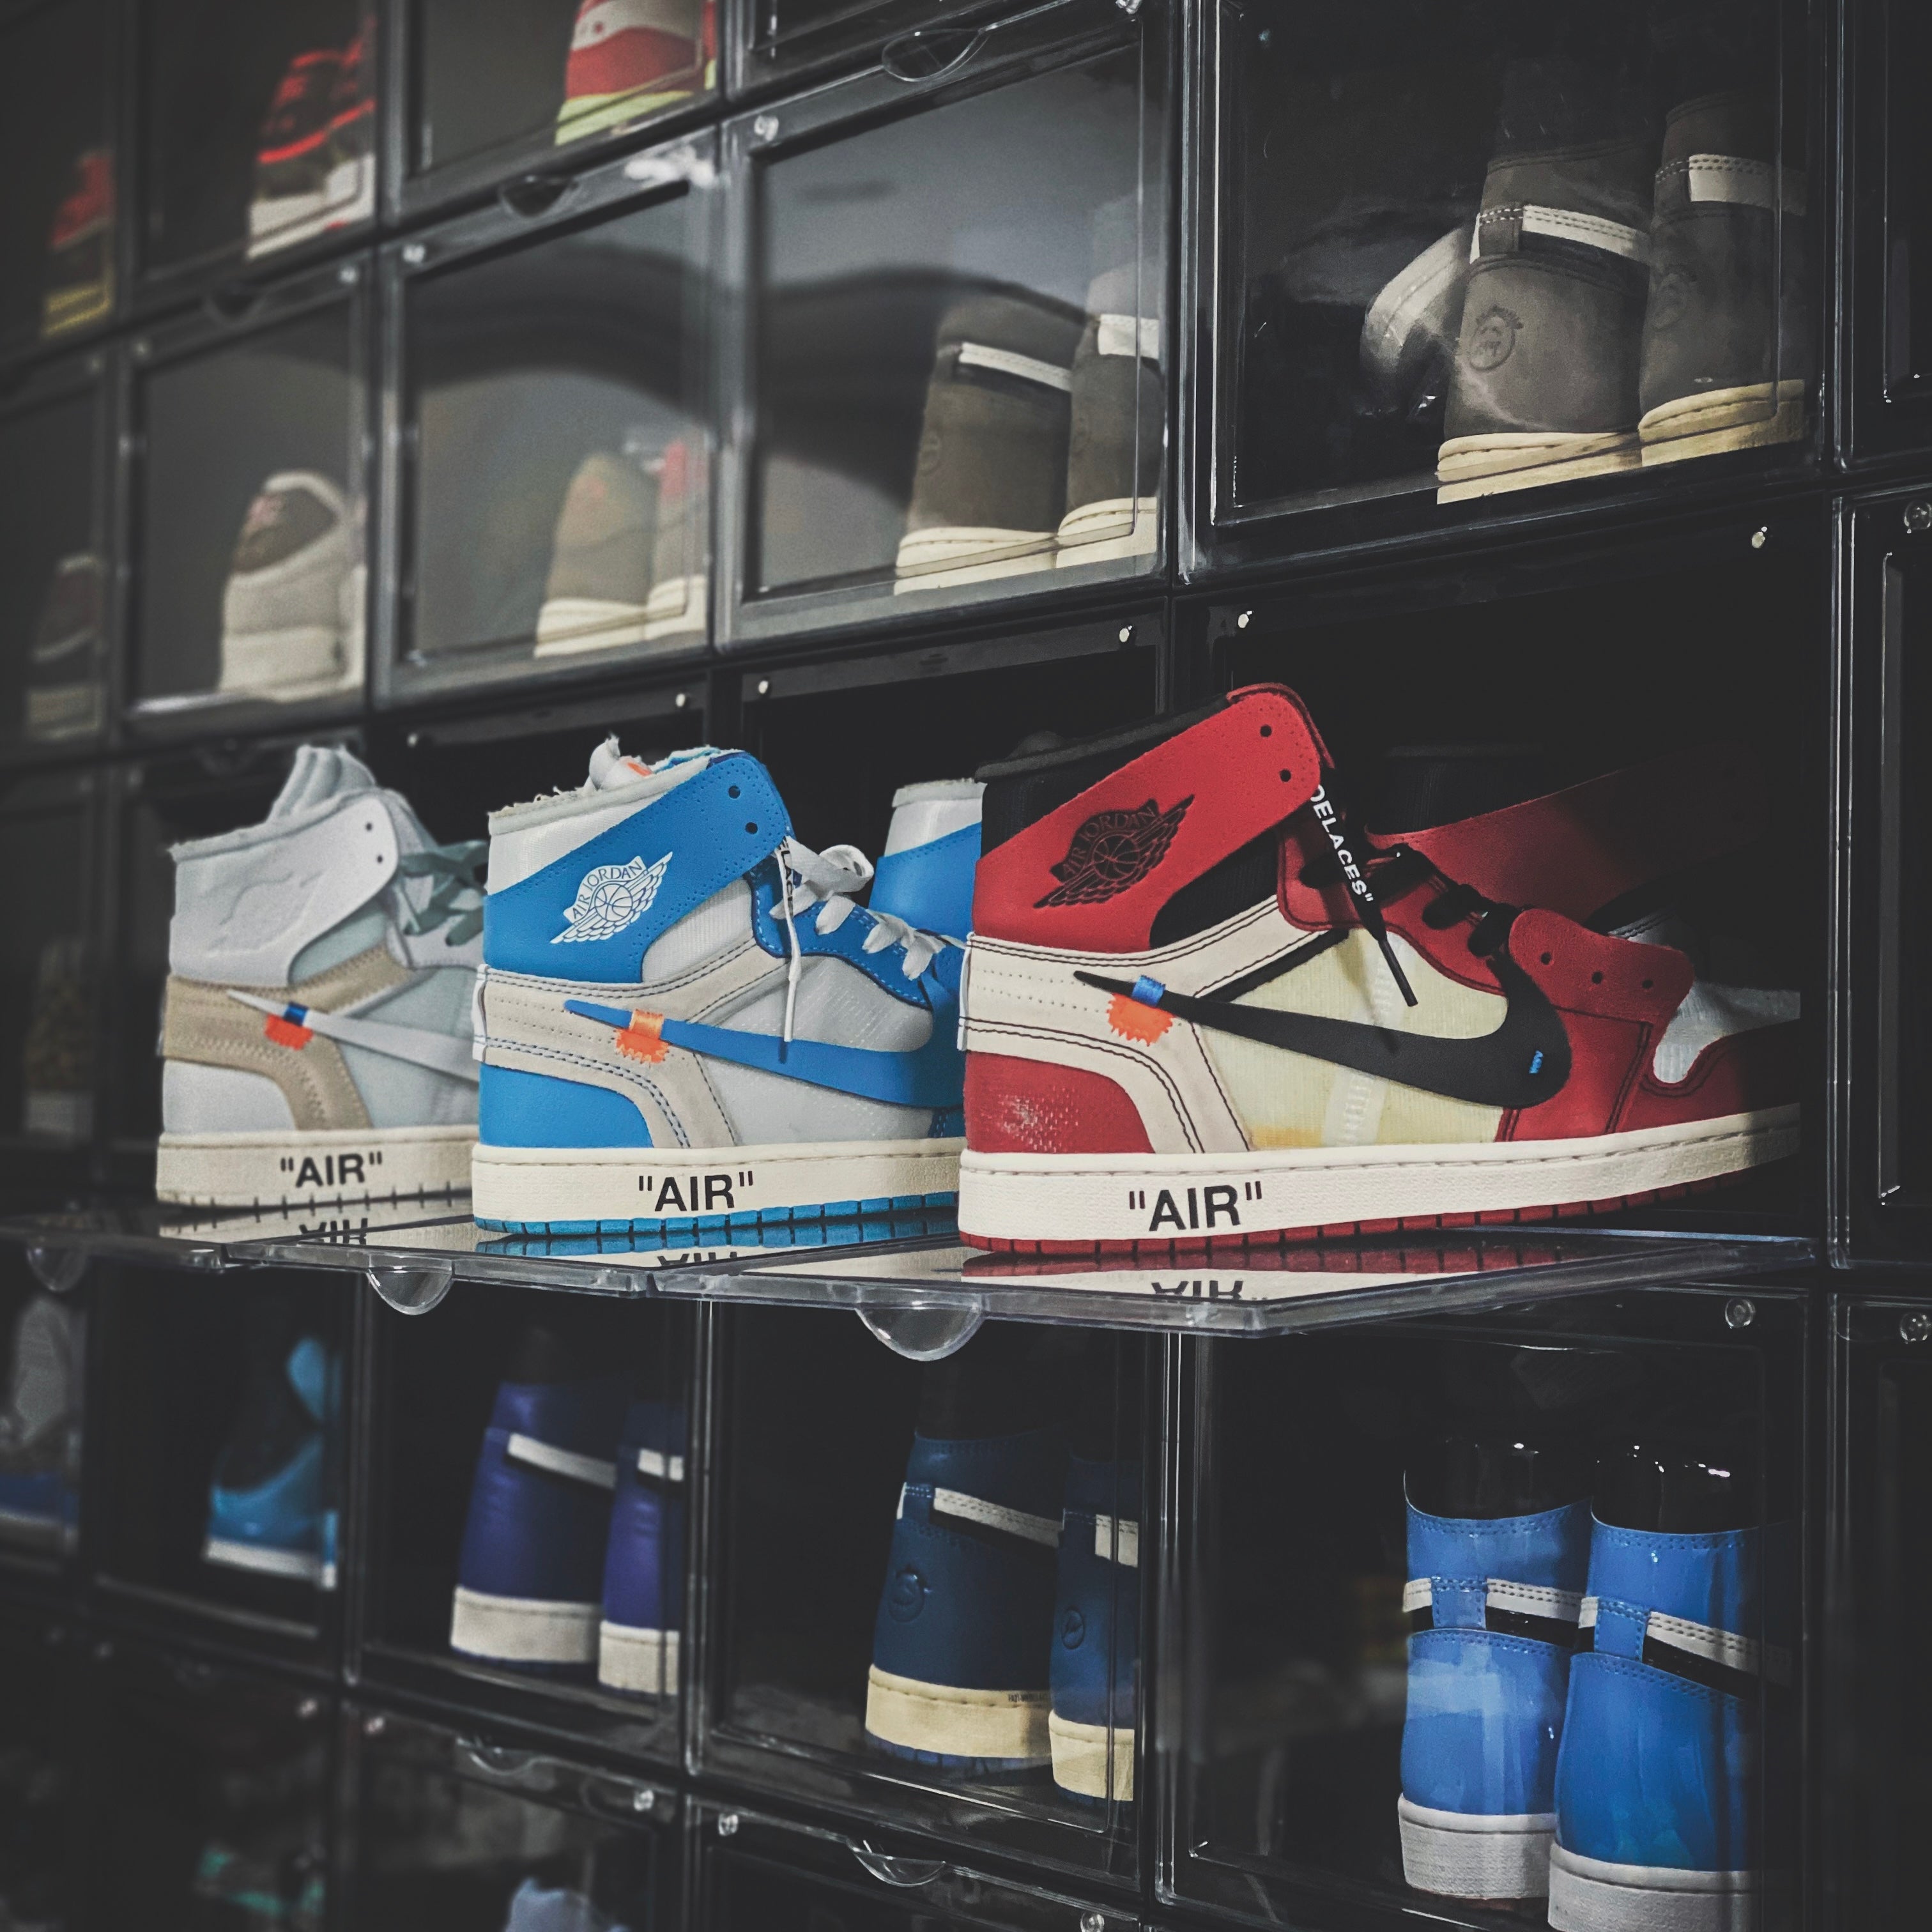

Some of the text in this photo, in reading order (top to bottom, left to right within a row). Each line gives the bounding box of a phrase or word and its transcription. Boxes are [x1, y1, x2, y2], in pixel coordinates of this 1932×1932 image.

[1062, 806, 1156, 880] AIR JORDAN
[572, 861, 643, 919] AIR JORDAN
[280, 1151, 382, 1188] "AIR"
[639, 1170, 753, 1212] "AIR"
[1129, 1181, 1262, 1232] "AIR"
